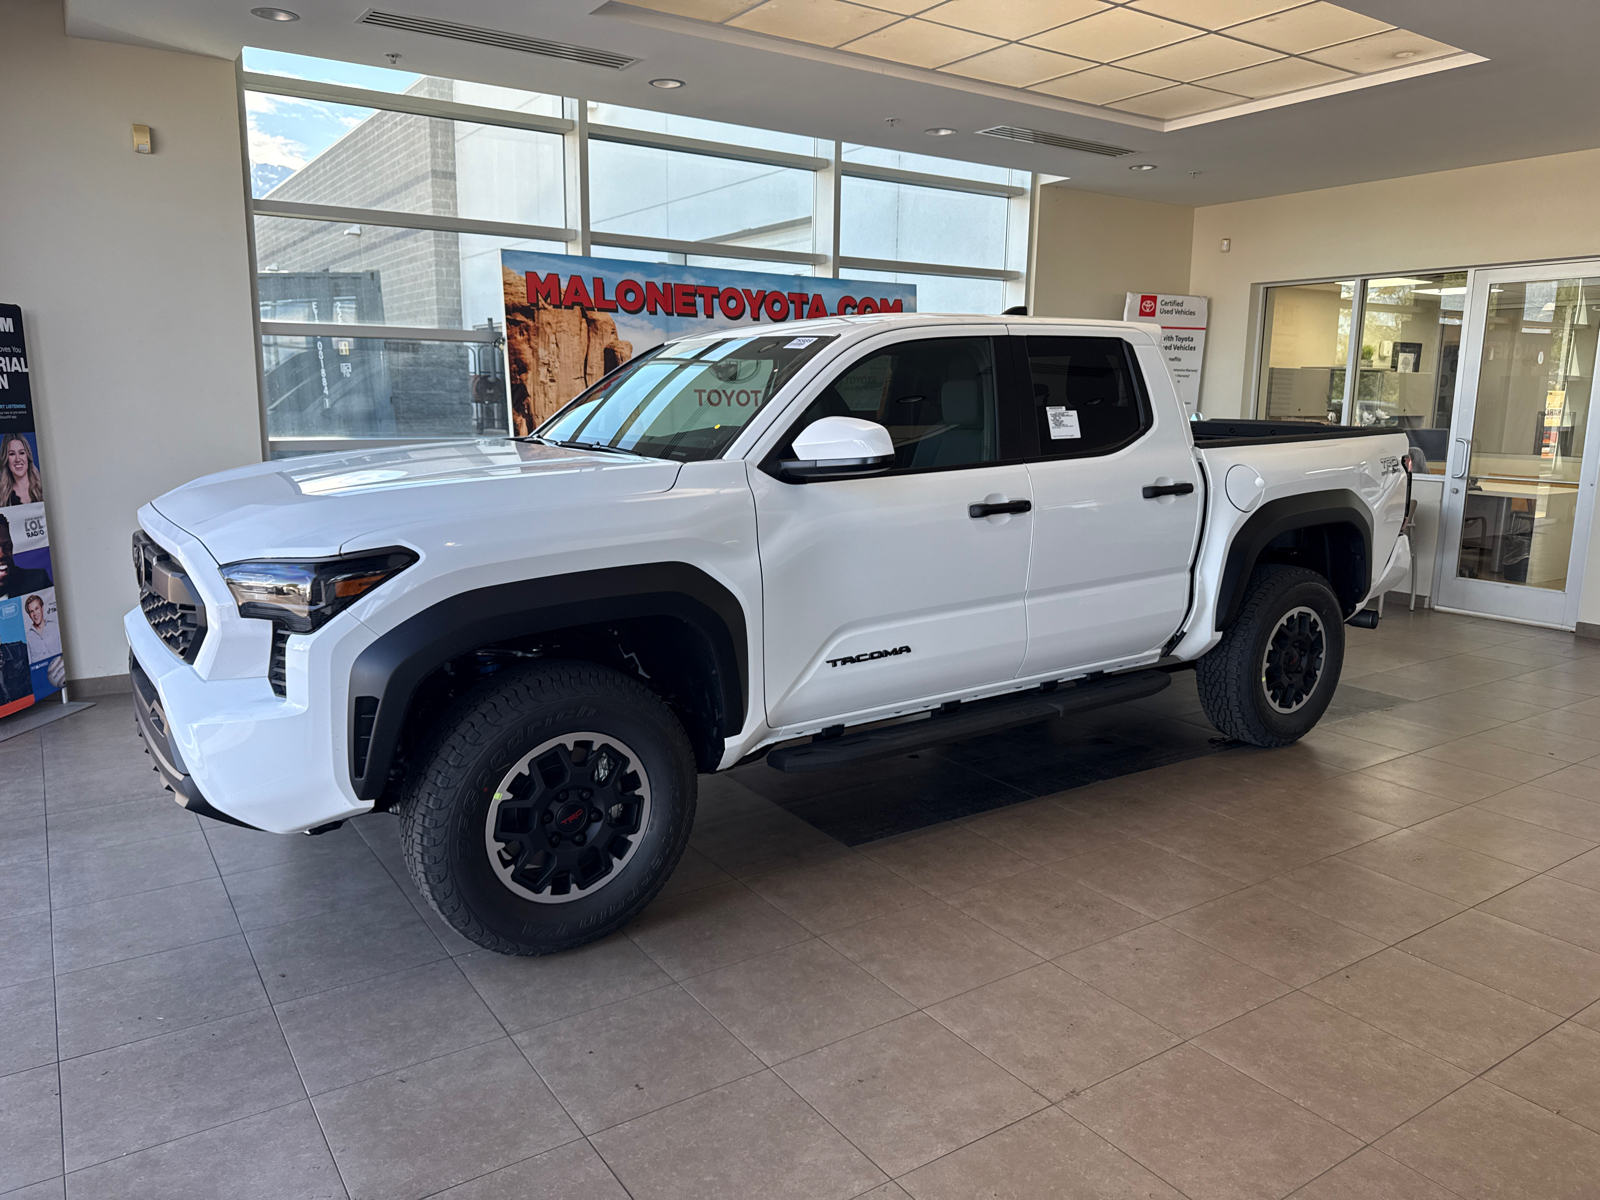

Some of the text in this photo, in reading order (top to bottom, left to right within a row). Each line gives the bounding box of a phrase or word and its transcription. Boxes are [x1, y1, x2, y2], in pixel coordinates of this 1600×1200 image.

[525, 271, 903, 322] MALONETOYOTA.COM
[1160, 299, 1184, 307] Certified
[1160, 307, 1196, 316] Used Vehicles
[1175, 335, 1194, 344] Toyota
[1173, 344, 1196, 352] Vehicles
[845, 376, 876, 384] TOYOTA
[693, 388, 762, 407] TOYOT
[1380, 455, 1399, 469] TRD
[25, 519, 43, 532] LOL
[825, 645, 912, 668] TACOMA
[560, 808, 583, 825] TRD
